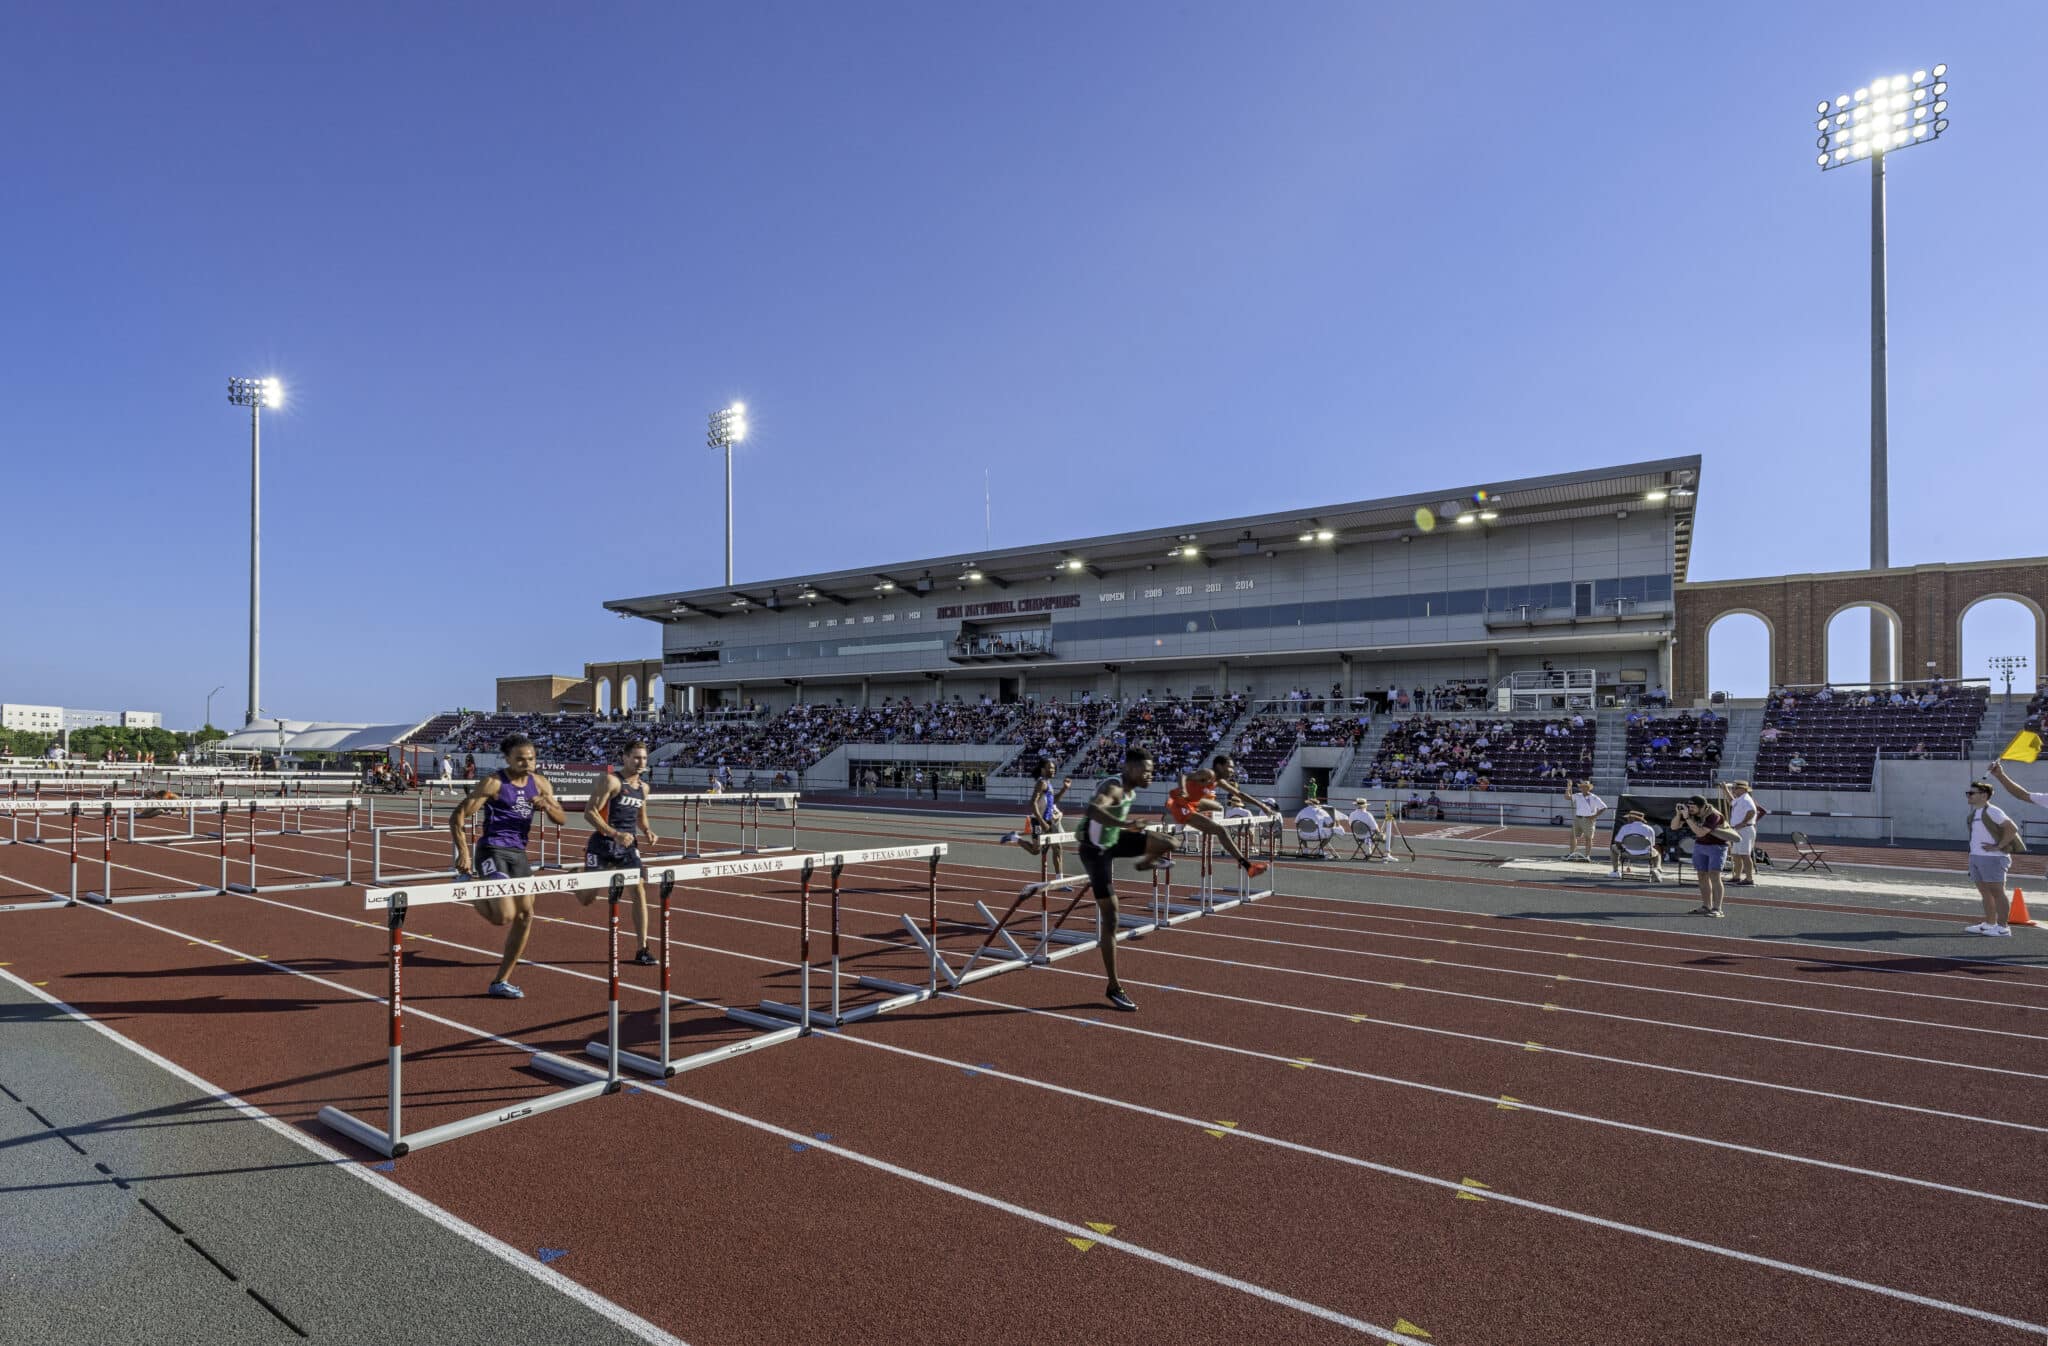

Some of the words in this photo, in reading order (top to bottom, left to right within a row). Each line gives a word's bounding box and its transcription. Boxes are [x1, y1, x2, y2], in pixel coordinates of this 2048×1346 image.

[1099, 592, 1125, 602] WOMEN
[1144, 588, 1163, 598] 2009
[1175, 586, 1193, 596] 2010
[1205, 583, 1222, 593] 2011
[1235, 580, 1254, 590] 2014
[548, 776, 593, 784] HENDERSON
[871, 850, 895, 861] TEXAS
[897, 848, 912, 858] A&M
[485, 860, 495, 873] 2
[715, 863, 750, 876] TEXAS
[751, 861, 773, 873] A&M
[473, 879, 526, 898] TEXAS
[530, 878, 562, 893] A&M
[367, 895, 391, 904] UCS
[499, 1107, 533, 1122] UCS
